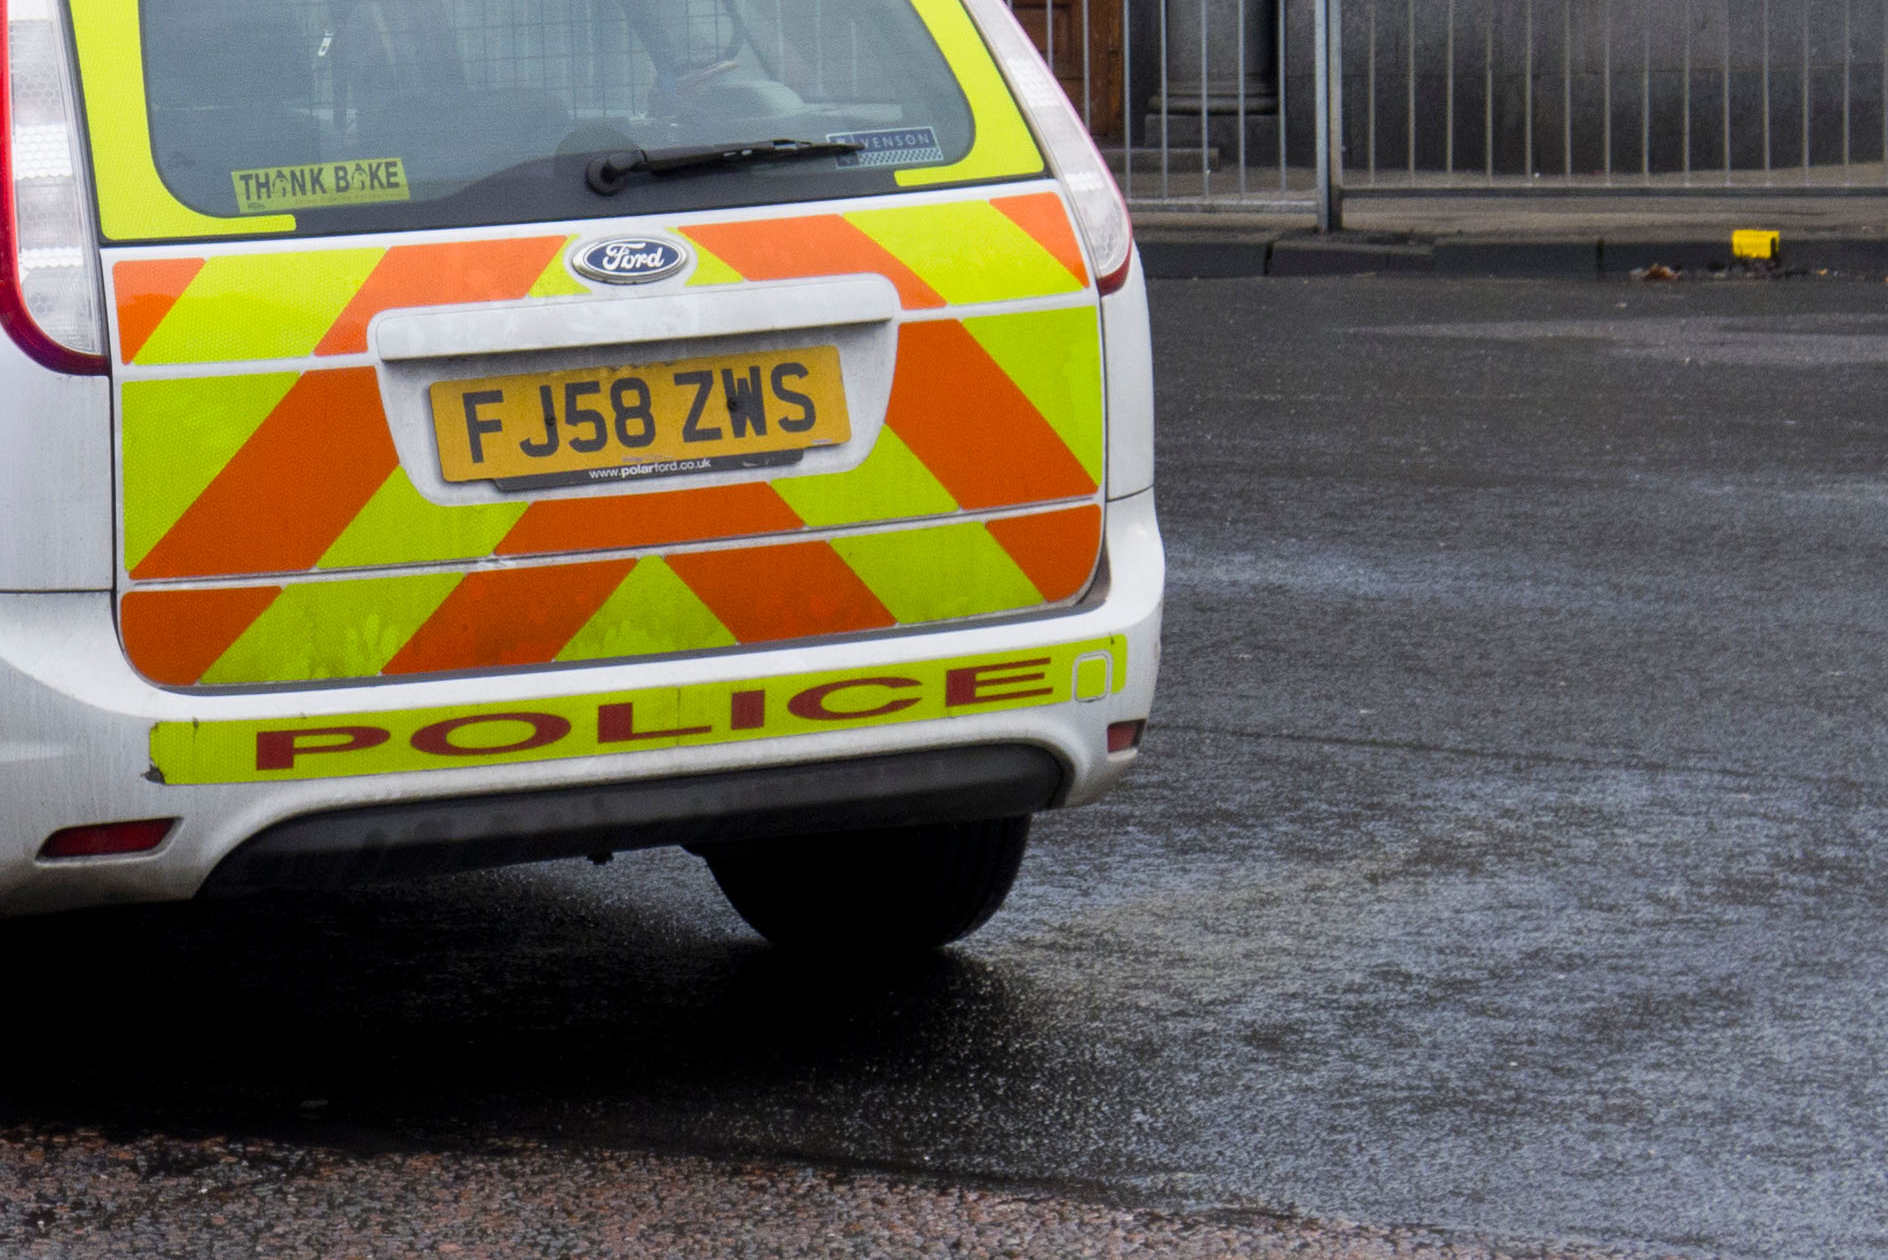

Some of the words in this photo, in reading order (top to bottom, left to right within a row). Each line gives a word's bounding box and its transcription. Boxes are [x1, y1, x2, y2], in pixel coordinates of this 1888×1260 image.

[860, 132, 930, 149] VENSON
[602, 242, 665, 271] Ford
[461, 376, 657, 464] FJ58
[673, 361, 817, 443] ZWS
[588, 458, 712, 479] www.polarford.co.uk
[255, 657, 1054, 772] POLICE
